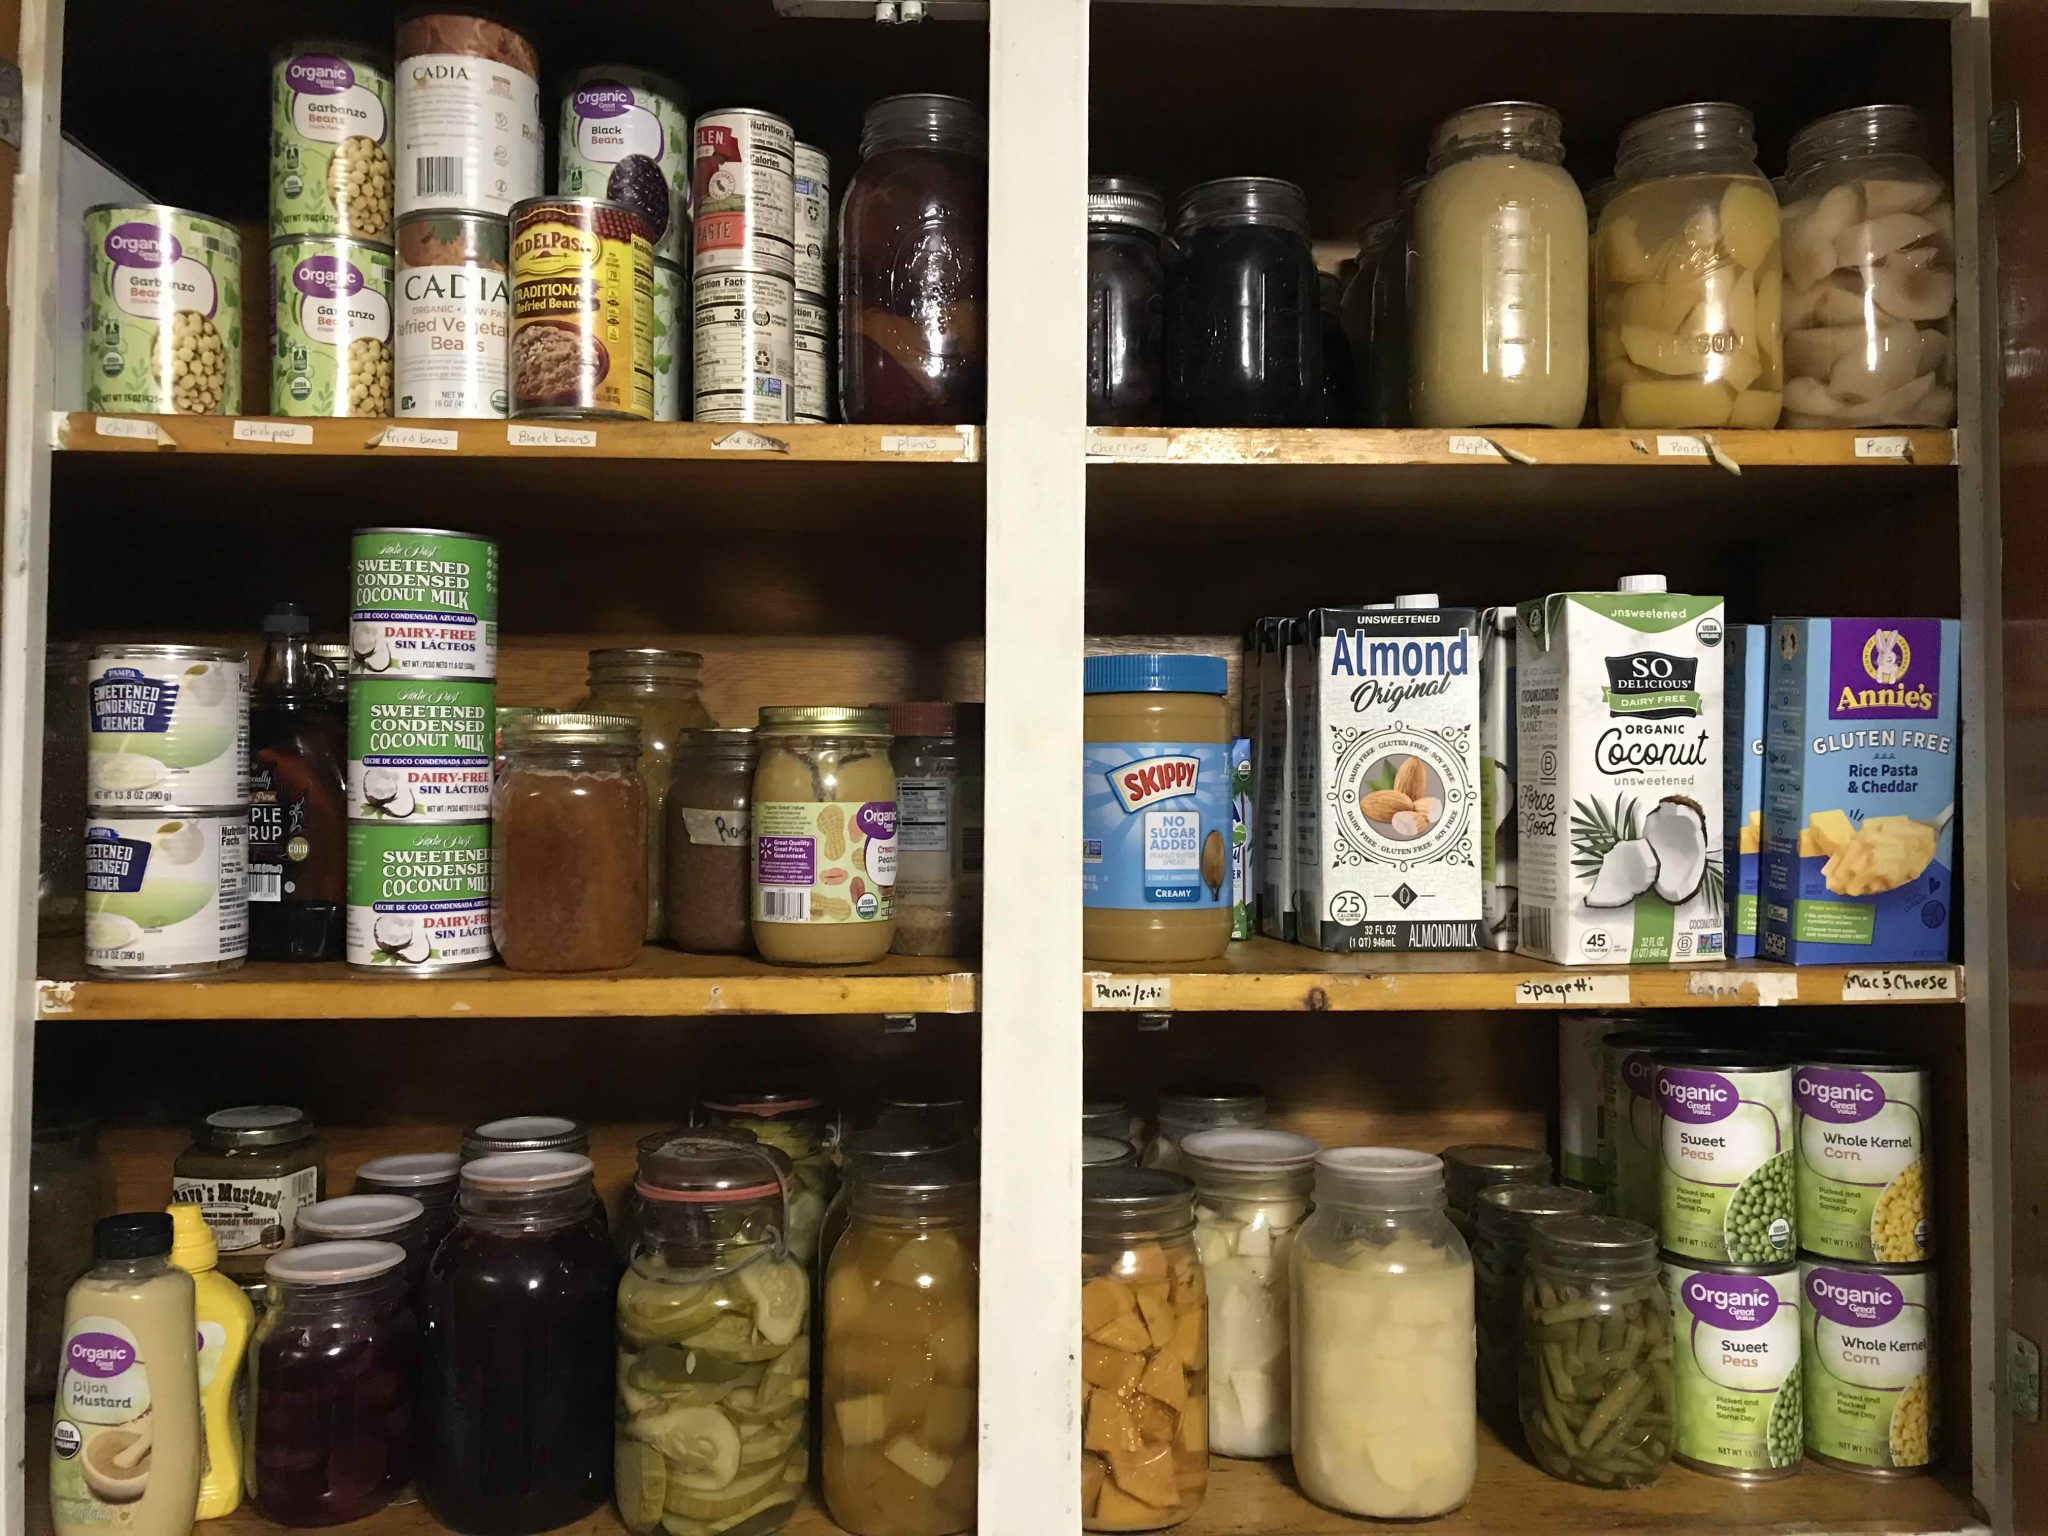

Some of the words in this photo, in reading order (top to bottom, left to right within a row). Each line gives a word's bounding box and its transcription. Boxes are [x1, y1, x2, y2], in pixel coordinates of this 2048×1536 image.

[291, 65, 347, 81] Organic
[413, 66, 469, 81] CADIA
[577, 90, 627, 106] Organic
[308, 103, 367, 119] Garbanzo
[308, 113, 345, 125] Beans
[591, 126, 621, 135] Black
[750, 120, 784, 137] Nutrition
[786, 131, 795, 142] Fac
[591, 136, 624, 145] Beans
[750, 155, 780, 169] Calories
[110, 235, 171, 254] Organ
[514, 233, 533, 261] OLD
[534, 232, 550, 250] EL
[551, 231, 592, 252] Pas
[130, 276, 195, 293] Garbnzo
[405, 274, 510, 304] CADIA
[514, 283, 592, 301] TRADITIONA
[517, 298, 546, 313] Refried
[549, 297, 582, 310] Beans
[518, 430, 549, 444] Black
[555, 432, 591, 446] beans
[897, 437, 938, 449] plums
[1091, 441, 1148, 453] Cherries
[357, 559, 470, 576] SWEETENED
[357, 573, 470, 589] CONDENSED
[356, 587, 425, 607] COCONUT
[431, 589, 469, 611] MILK
[1357, 615, 1441, 624] UNSWEETENED
[1611, 608, 1687, 619] unsweetened
[384, 626, 476, 641] DAIRY-FREE
[395, 640, 416, 649] SIN
[421, 639, 476, 652] LÁCTEOS
[1331, 628, 1469, 677] Almond
[1632, 657, 1673, 678] SO
[1618, 679, 1689, 689] DELICIOUS
[94, 684, 160, 702] SWEETENED
[1350, 671, 1452, 713] Original
[1836, 683, 1933, 711] Annie's
[96, 699, 156, 716] CONDENSED
[1621, 697, 1654, 707] DAIRY
[1657, 694, 1686, 704] FREE
[370, 704, 485, 719] SWEETENED
[102, 716, 145, 731] CREAMER
[370, 718, 485, 732] CONDENSED
[1625, 725, 1685, 735] ORGANIC
[370, 732, 449, 751] COCONUT
[454, 733, 485, 753] MILK
[1813, 730, 1895, 755] GLUTEN
[1901, 730, 1951, 755] FREE
[1595, 729, 1709, 775] Coconut
[364, 757, 380, 765] LECHE
[382, 757, 391, 765] DE
[392, 757, 412, 765] COCO
[414, 757, 460, 765] CONDENSADA
[1348, 763, 1361, 783] DAIRY
[1359, 747, 1376, 763] FREE
[1378, 739, 1408, 749] GLUTEN
[1409, 741, 1430, 753] FREE
[1430, 752, 1443, 764] SOY
[1441, 764, 1456, 783] FREE
[1849, 764, 1878, 777] Rice
[1881, 763, 1918, 777] Pasta
[407, 772, 489, 783] DAIRY-FREE
[1124, 761, 1196, 802] SKIPPY
[1614, 775, 1694, 786] unsweetened
[419, 785, 441, 794] SIN
[445, 783, 489, 794] LÁCTEOS
[1848, 782, 1859, 793] &
[1862, 780, 1918, 793] Cheddar
[1520, 784, 1555, 811] Force
[251, 807, 282, 823] PLE
[863, 808, 897, 826] Organic
[1163, 816, 1185, 827] NO
[250, 824, 282, 841] RUP
[1521, 812, 1557, 839] Good
[1150, 828, 1196, 839] SUGAR
[288, 844, 308, 854] GOLD
[789, 839, 813, 847] Quality.
[1150, 839, 1196, 851] ADDED
[382, 877, 462, 898] COCONUT
[1155, 889, 1192, 898] CREAMY
[1336, 896, 1360, 913] 25
[1365, 925, 1374, 934] 32
[1375, 925, 1384, 934] FL
[1386, 925, 1397, 934] OZ
[1408, 923, 1477, 948] ALMONDMILK
[1349, 937, 1356, 949] (1
[1358, 937, 1371, 949] QT)
[1373, 937, 1396, 948] 946mL
[1587, 934, 1606, 947] 45
[1641, 937, 1648, 947] 32
[1656, 936, 1664, 947] OZ
[1847, 975, 1877, 989] Mac
[1894, 974, 1948, 990] Cheese
[1095, 983, 1162, 1005] Penni/ziti
[1522, 974, 1592, 1005] Spagetti
[1660, 1078, 1728, 1103] Organic
[1798, 1078, 1874, 1103] Organic
[1686, 1101, 1711, 1111] Great
[1830, 1101, 1857, 1111] Great
[1837, 1108, 1856, 1116] Value
[1680, 1132, 1726, 1148] Sweet
[1823, 1132, 1868, 1147] Whole
[1871, 1136, 1912, 1148] Kernel
[1680, 1147, 1714, 1160] Peas
[1824, 1147, 1861, 1161] Corn
[173, 1183, 215, 1203] Raye's
[218, 1182, 282, 1210] Mustard
[1676, 1186, 1698, 1197] Picked
[1700, 1190, 1715, 1199] and
[1676, 1195, 1701, 1204] Packed
[1676, 1202, 1697, 1212] Same
[1698, 1206, 1711, 1215] Day
[243, 1217, 275, 1225] Molasses
[1691, 1283, 1769, 1310] Organic
[1813, 1278, 1893, 1305] Organic
[1729, 1307, 1755, 1316] Great
[1849, 1303, 1877, 1314] Great
[1856, 1312, 1877, 1320] Value
[1721, 1339, 1769, 1353] Sweet
[1841, 1335, 1887, 1351] Whole
[1889, 1338, 1927, 1352] Kernel
[72, 1344, 127, 1362] Organic
[1842, 1352, 1880, 1366] Corn
[1722, 1355, 1758, 1368] Peas
[73, 1381, 108, 1395] Dijon
[73, 1395, 132, 1409] Mustard
[1716, 1396, 1742, 1406] Picked
[1716, 1412, 1739, 1422] Same
[1740, 1414, 1755, 1423] Day
[57, 1428, 74, 1439] USDA
[56, 1441, 78, 1449] ORGANIC
